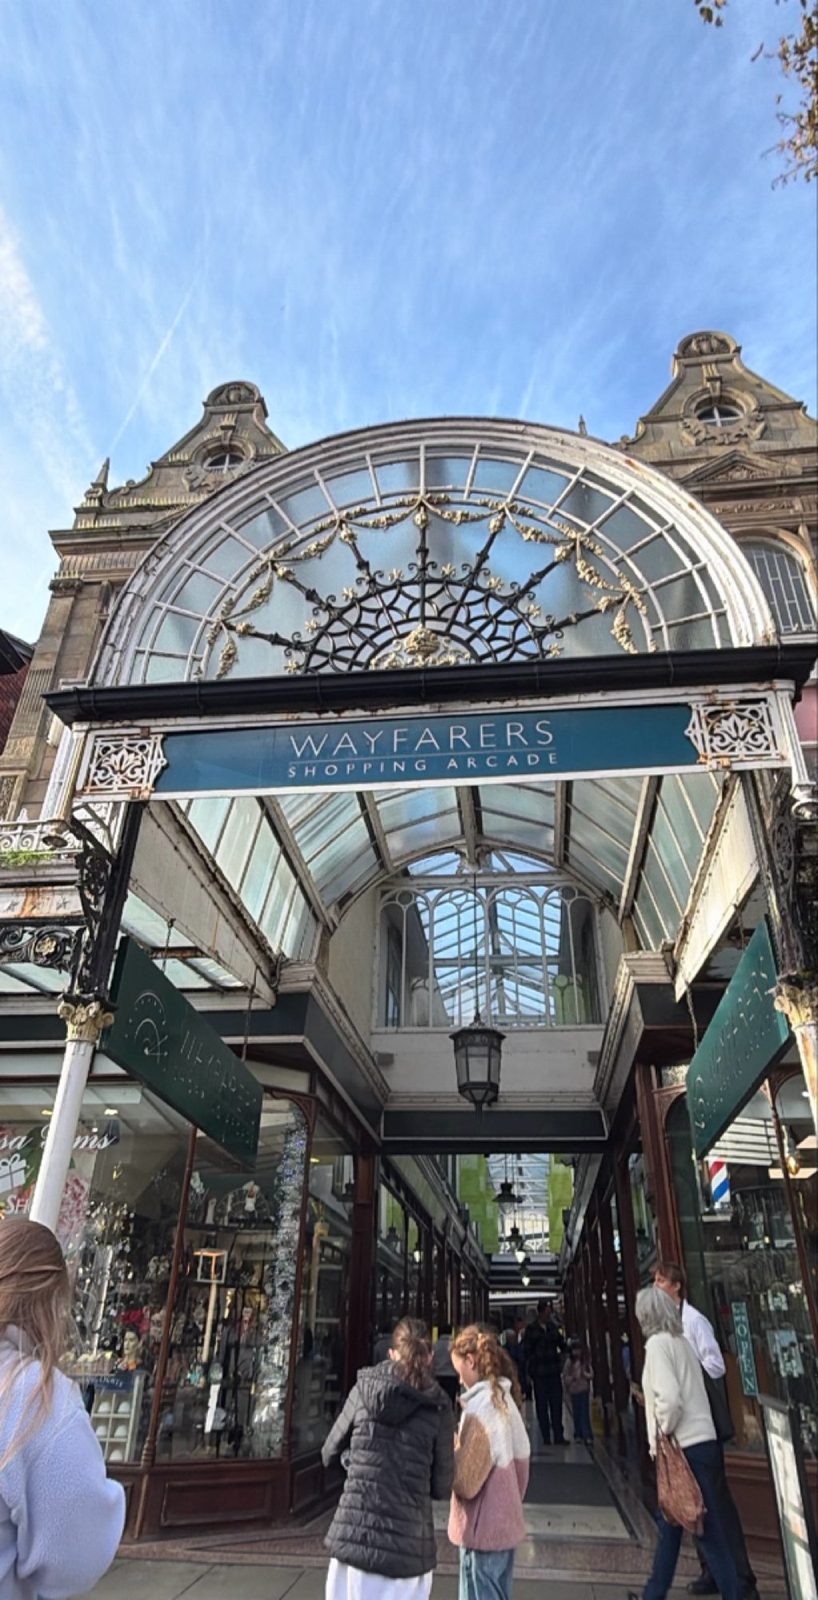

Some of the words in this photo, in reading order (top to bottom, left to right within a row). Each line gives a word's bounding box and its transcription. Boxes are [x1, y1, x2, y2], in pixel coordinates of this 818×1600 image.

[289, 719, 553, 758] WAYFARERS
[288, 759, 427, 778] SHOPPING
[446, 752, 558, 770] ARCADE
[737, 1323, 755, 1393] OPEN
